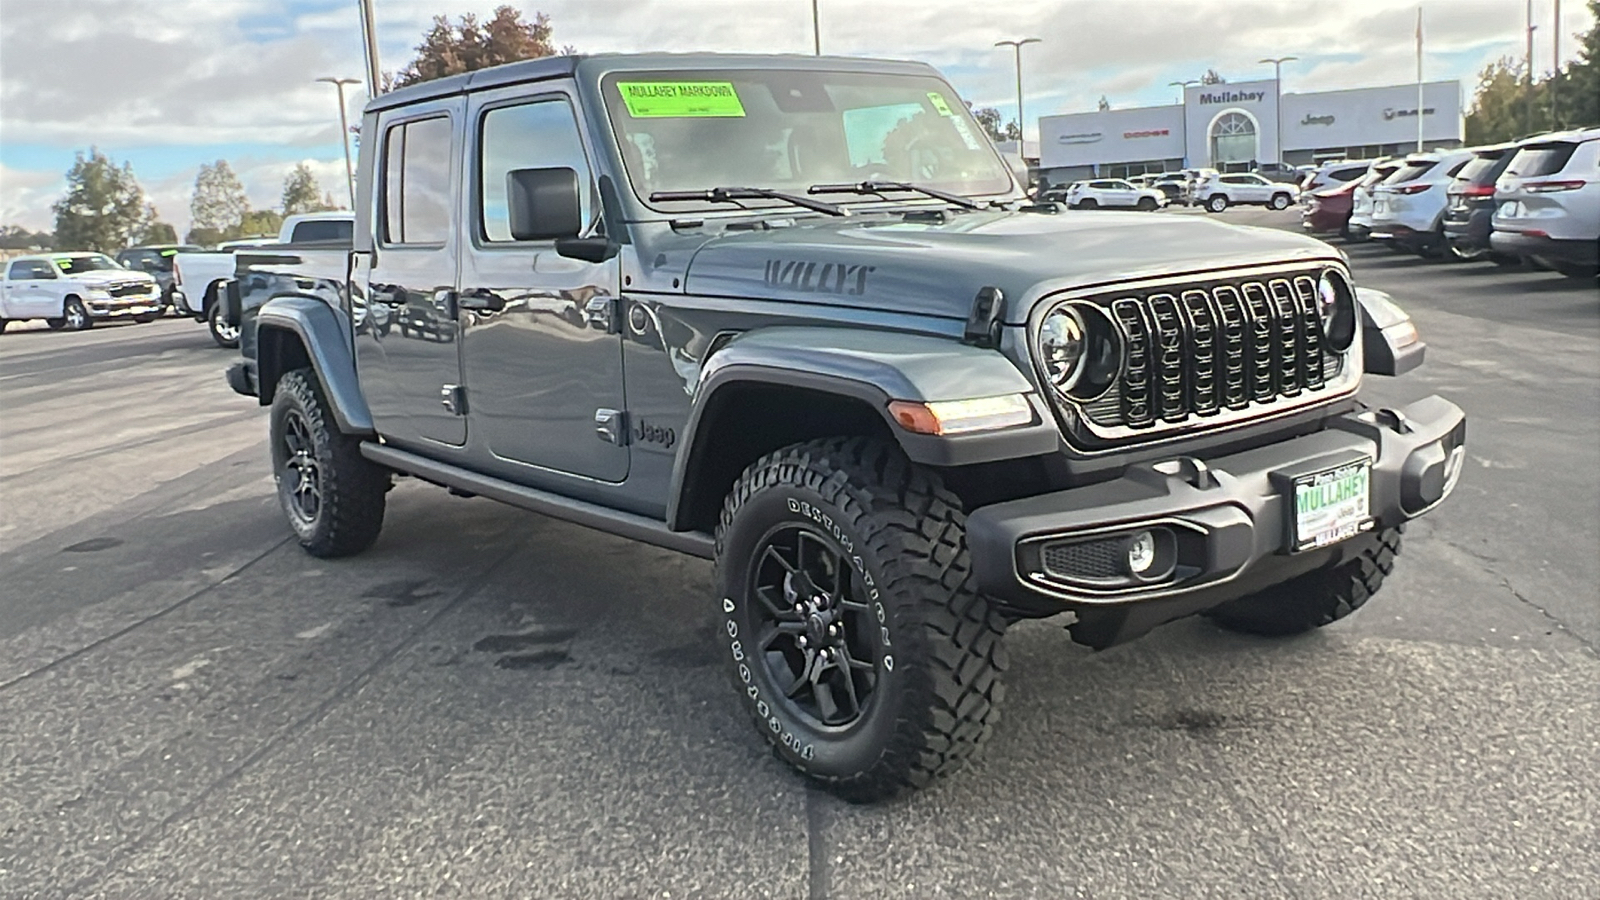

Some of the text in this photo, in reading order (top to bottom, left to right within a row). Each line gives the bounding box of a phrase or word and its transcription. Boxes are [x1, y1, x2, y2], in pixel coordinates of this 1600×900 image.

[628, 84, 732, 98] MULLAHEY MARKDOWN
[1200, 90, 1265, 104] Mullahey
[1301, 114, 1335, 126] Jeep
[764, 259, 876, 295] WILLYS
[634, 418, 675, 449] Jeep
[1297, 472, 1366, 514] MULLAHEY
